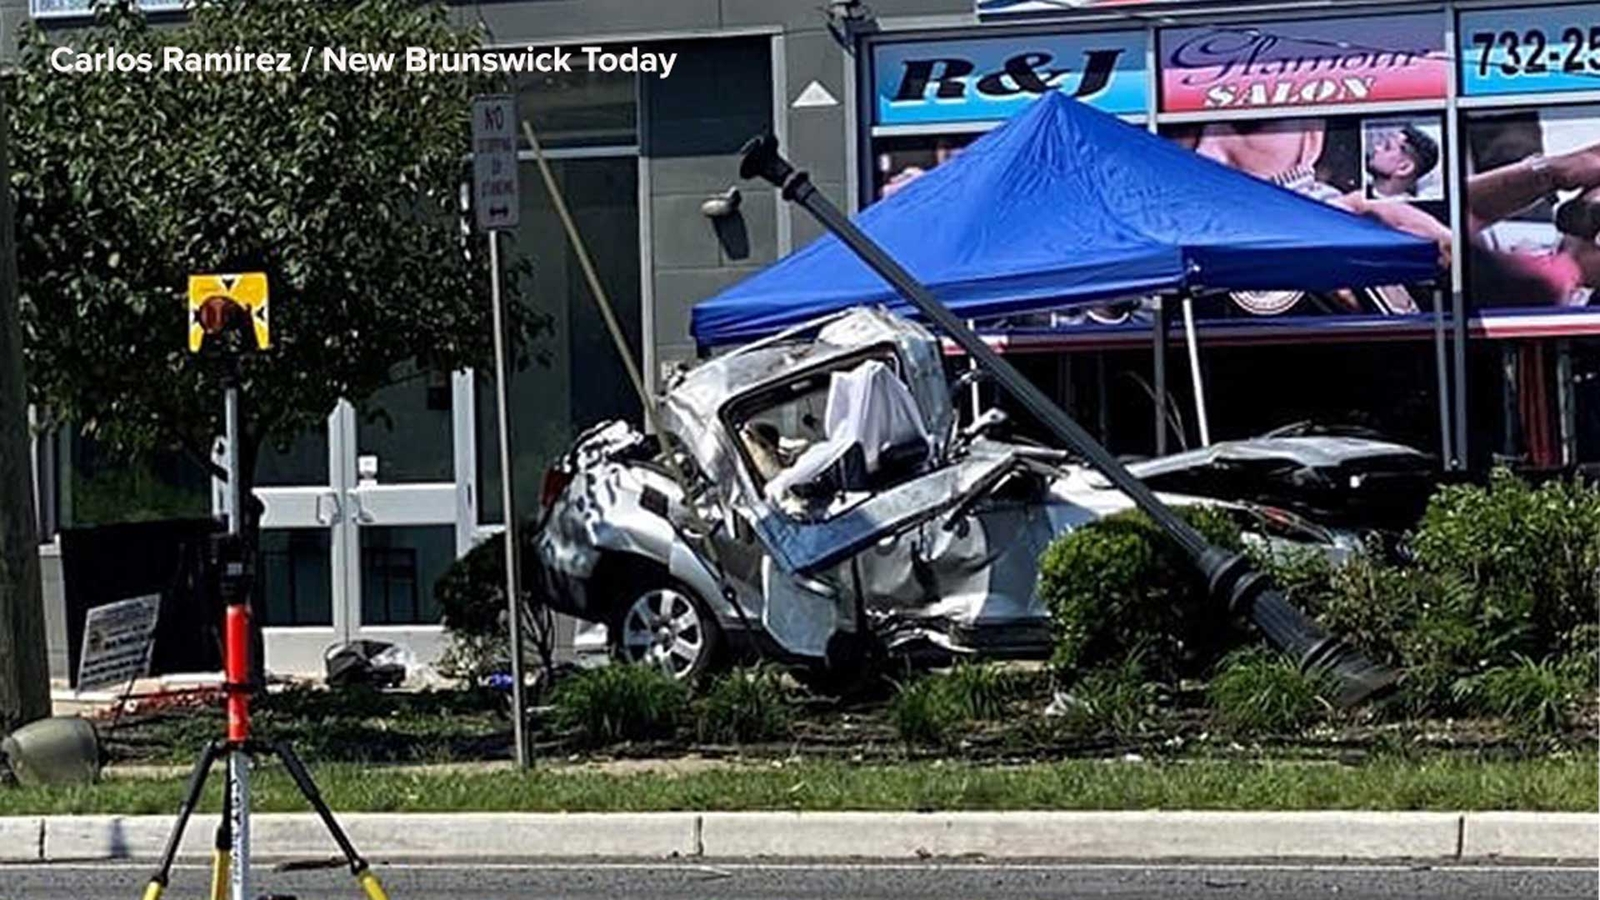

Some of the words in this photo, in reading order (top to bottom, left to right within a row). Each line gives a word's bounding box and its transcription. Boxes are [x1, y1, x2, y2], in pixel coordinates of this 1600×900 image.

[893, 49, 1126, 101] R&J
[1170, 28, 1430, 85] Glamour
[1473, 27, 1600, 76] 732-25
[1205, 76, 1376, 108] SALON
[484, 105, 504, 131] NO
